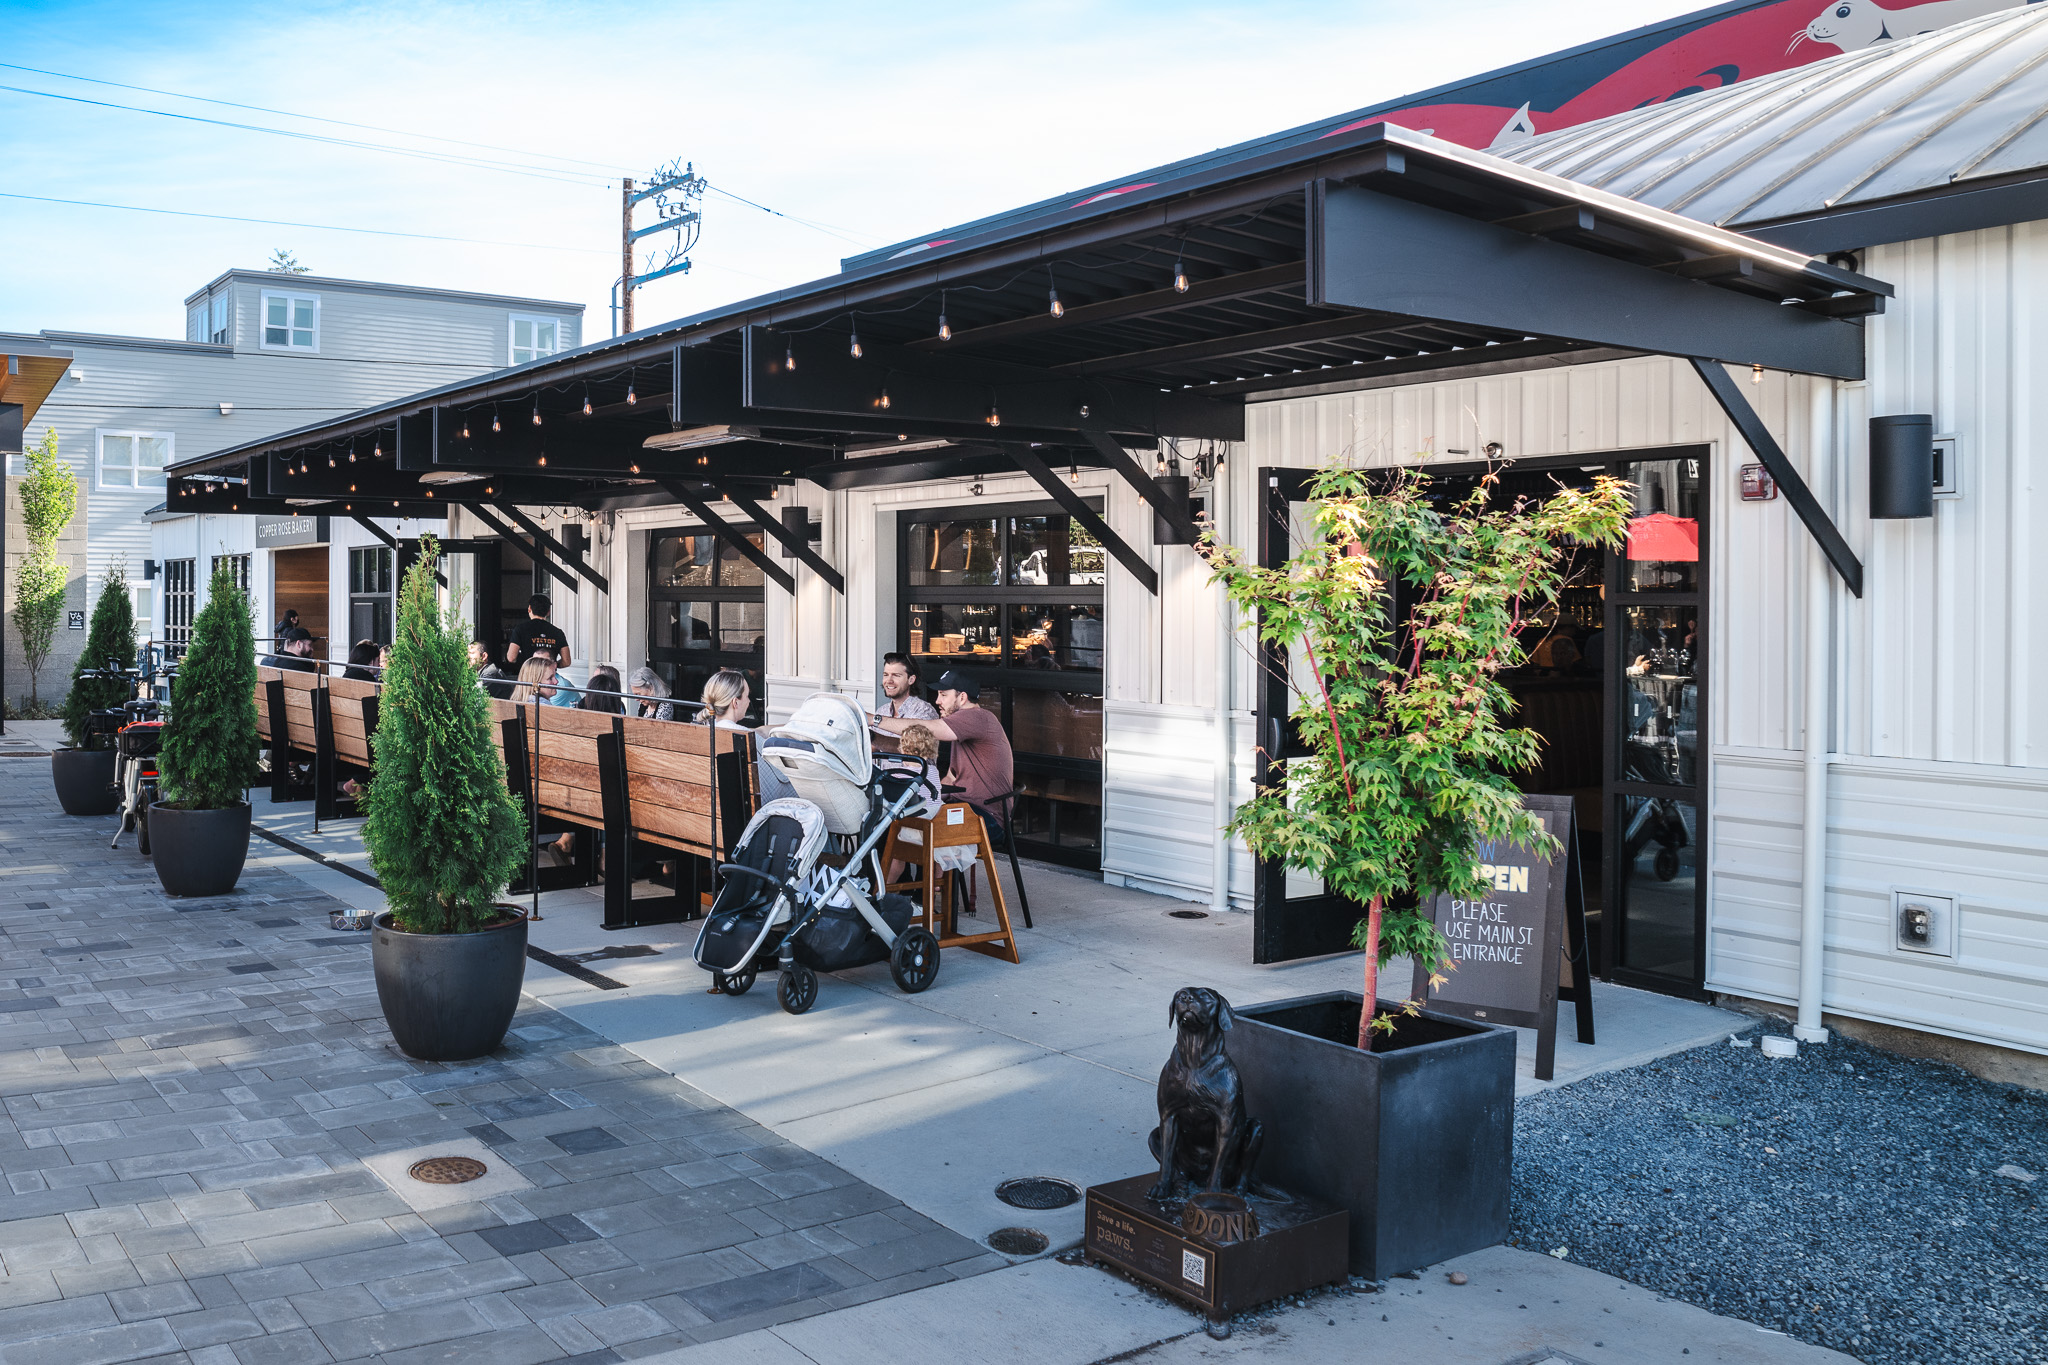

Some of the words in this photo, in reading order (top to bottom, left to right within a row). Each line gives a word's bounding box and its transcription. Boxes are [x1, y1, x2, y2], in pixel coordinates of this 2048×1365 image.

[259, 524, 277, 538] COPPER
[278, 521, 291, 535] ROSE
[292, 518, 314, 534] BAKERY
[531, 637, 556, 645] VICTOR
[1469, 840, 1496, 862] OW
[1452, 900, 1508, 923] PLEASE
[1445, 920, 1472, 940] USE
[1478, 924, 1515, 945] MAIN
[1453, 942, 1524, 965] ENTRANCE
[1096, 1209, 1114, 1225] Save
[1115, 1220, 1121, 1229] a
[1121, 1220, 1136, 1235] life.
[1096, 1225, 1134, 1253] paws.
